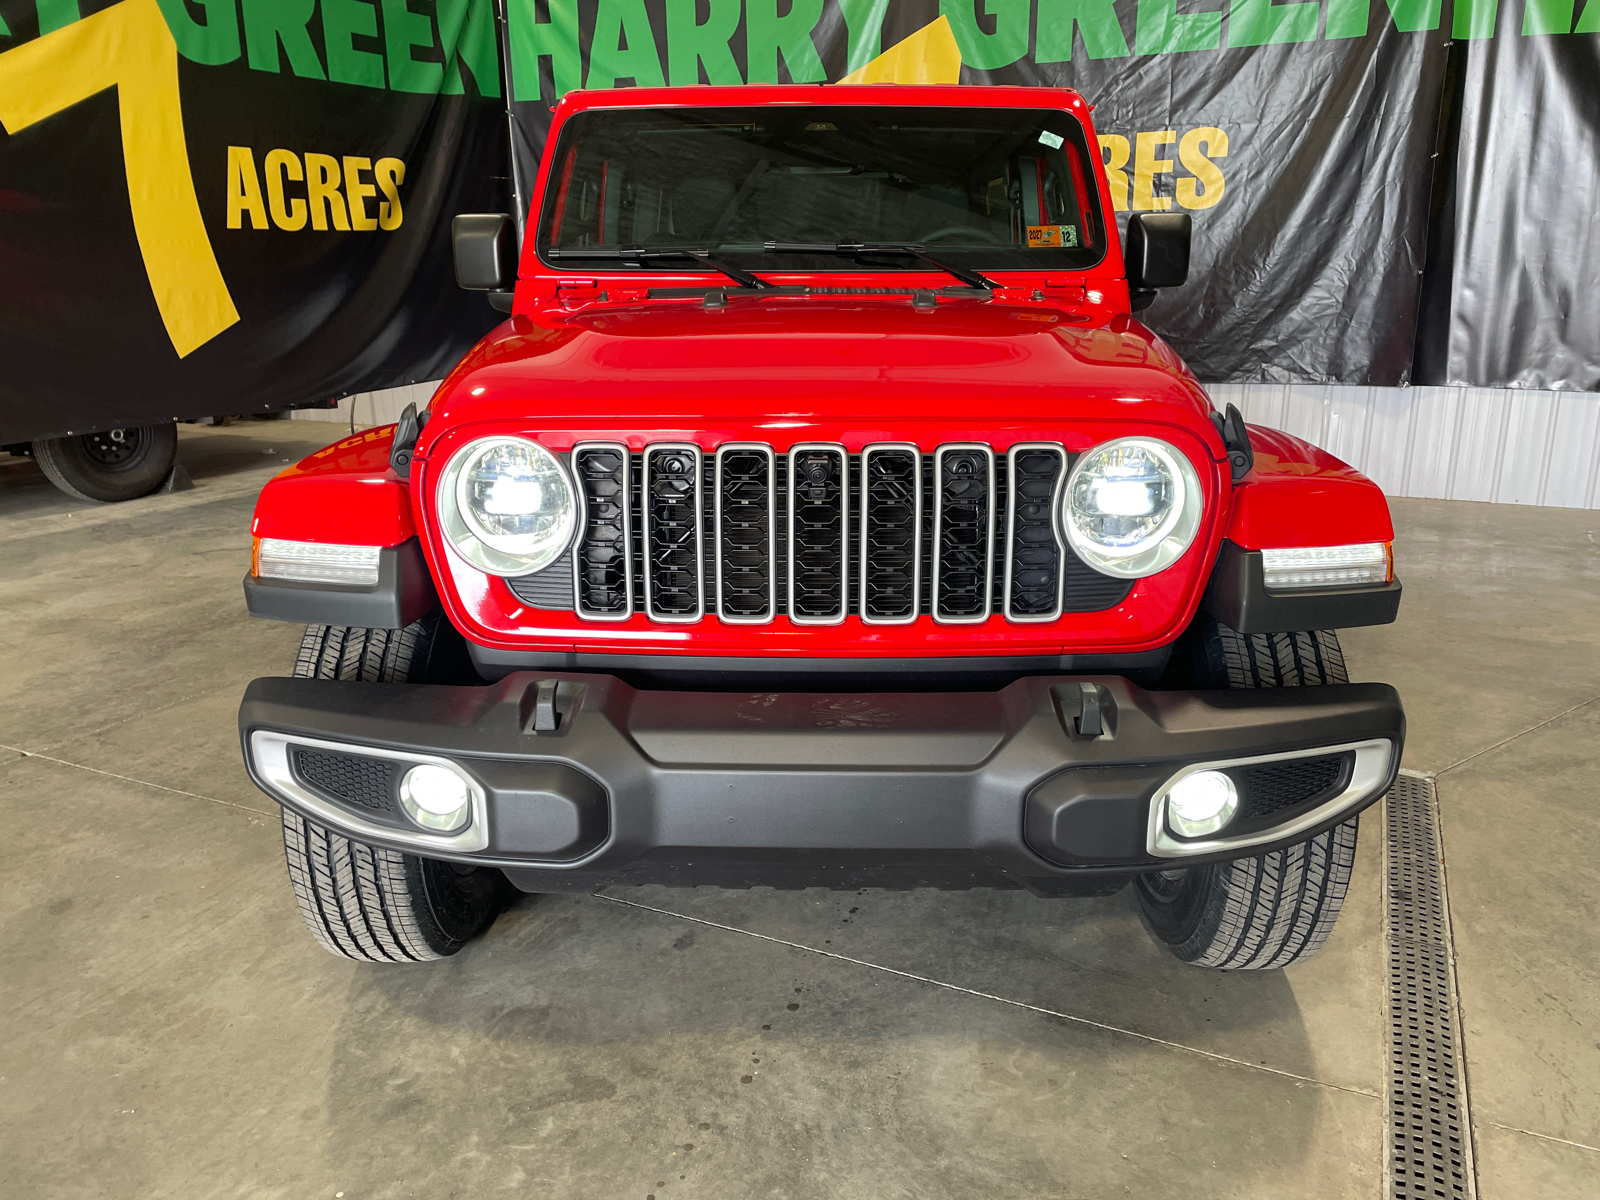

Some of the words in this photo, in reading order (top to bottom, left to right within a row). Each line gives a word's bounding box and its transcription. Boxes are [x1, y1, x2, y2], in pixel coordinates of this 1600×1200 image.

[227, 146, 406, 231] ACRES
[1097, 127, 1229, 211] RES
[1028, 230, 1043, 240] 2027
[1061, 231, 1072, 243] 12
